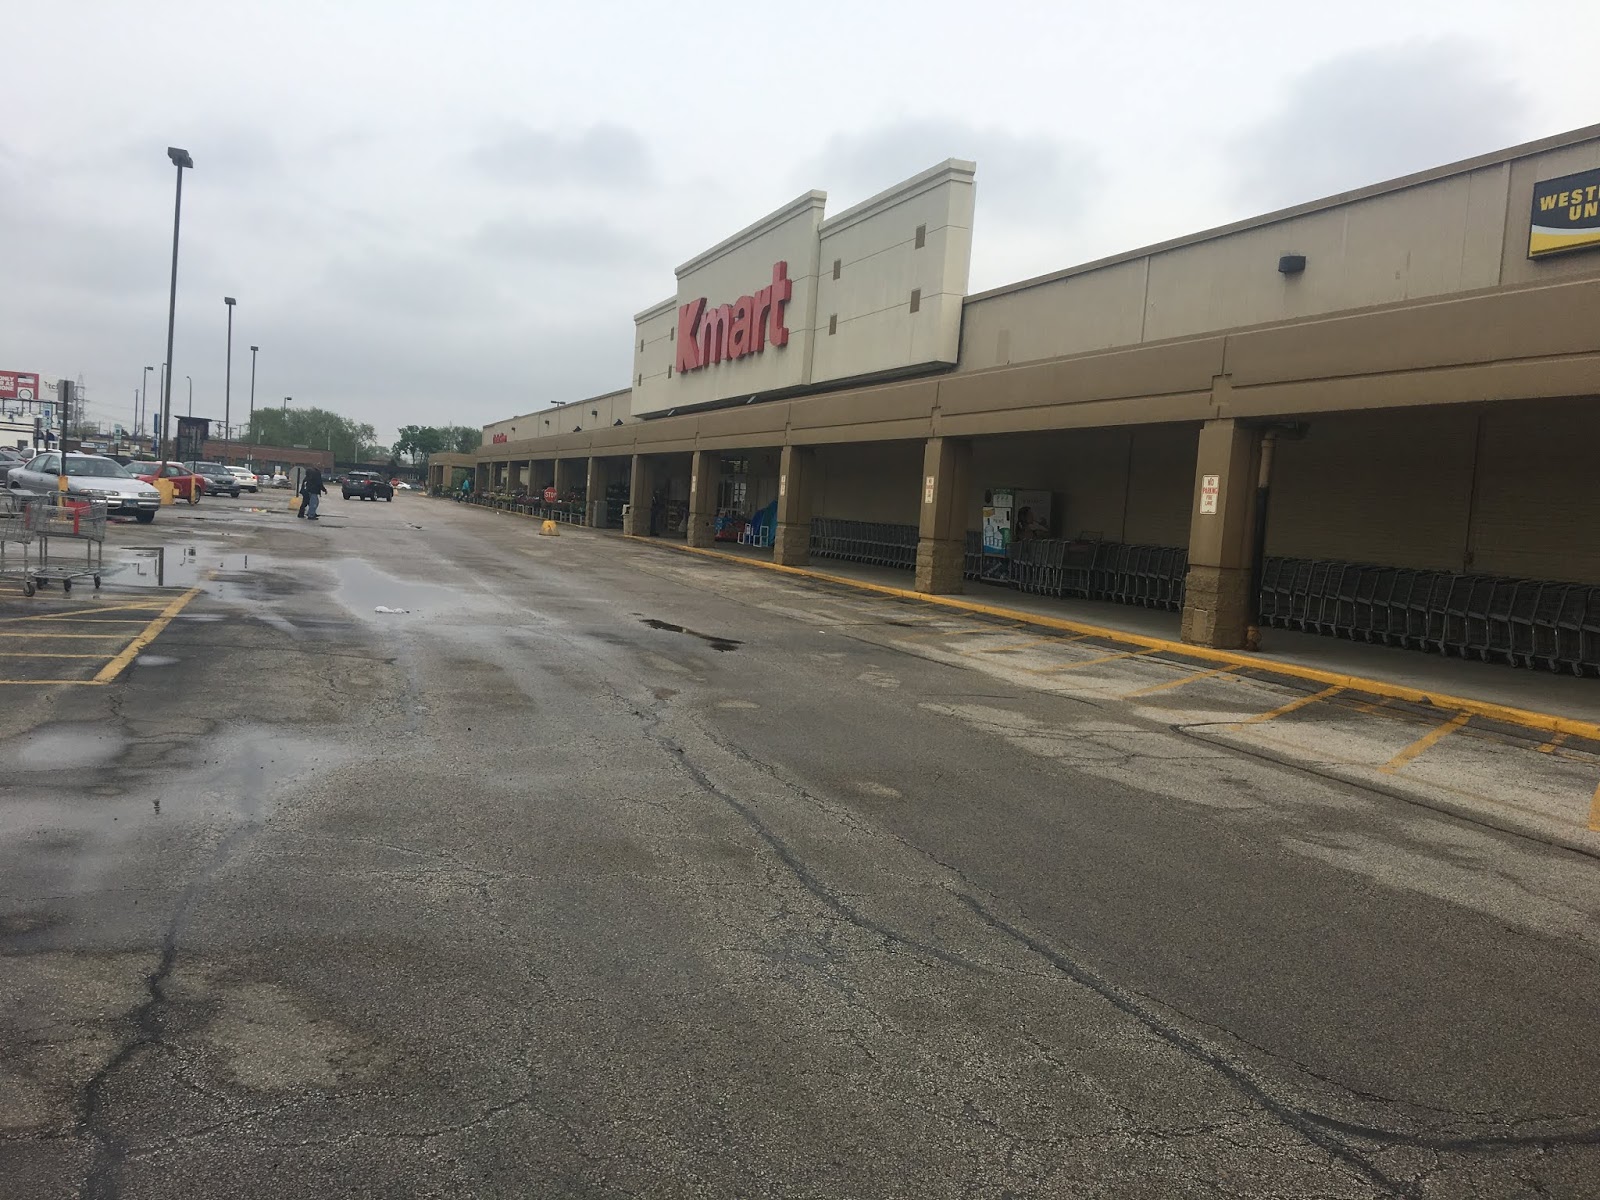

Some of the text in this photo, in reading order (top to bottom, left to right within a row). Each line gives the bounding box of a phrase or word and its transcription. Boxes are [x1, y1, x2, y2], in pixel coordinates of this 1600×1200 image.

[1540, 185, 1600, 211] WEST
[1569, 202, 1598, 221] UN
[676, 261, 792, 373] Kmart
[1208, 478, 1214, 486] NO
